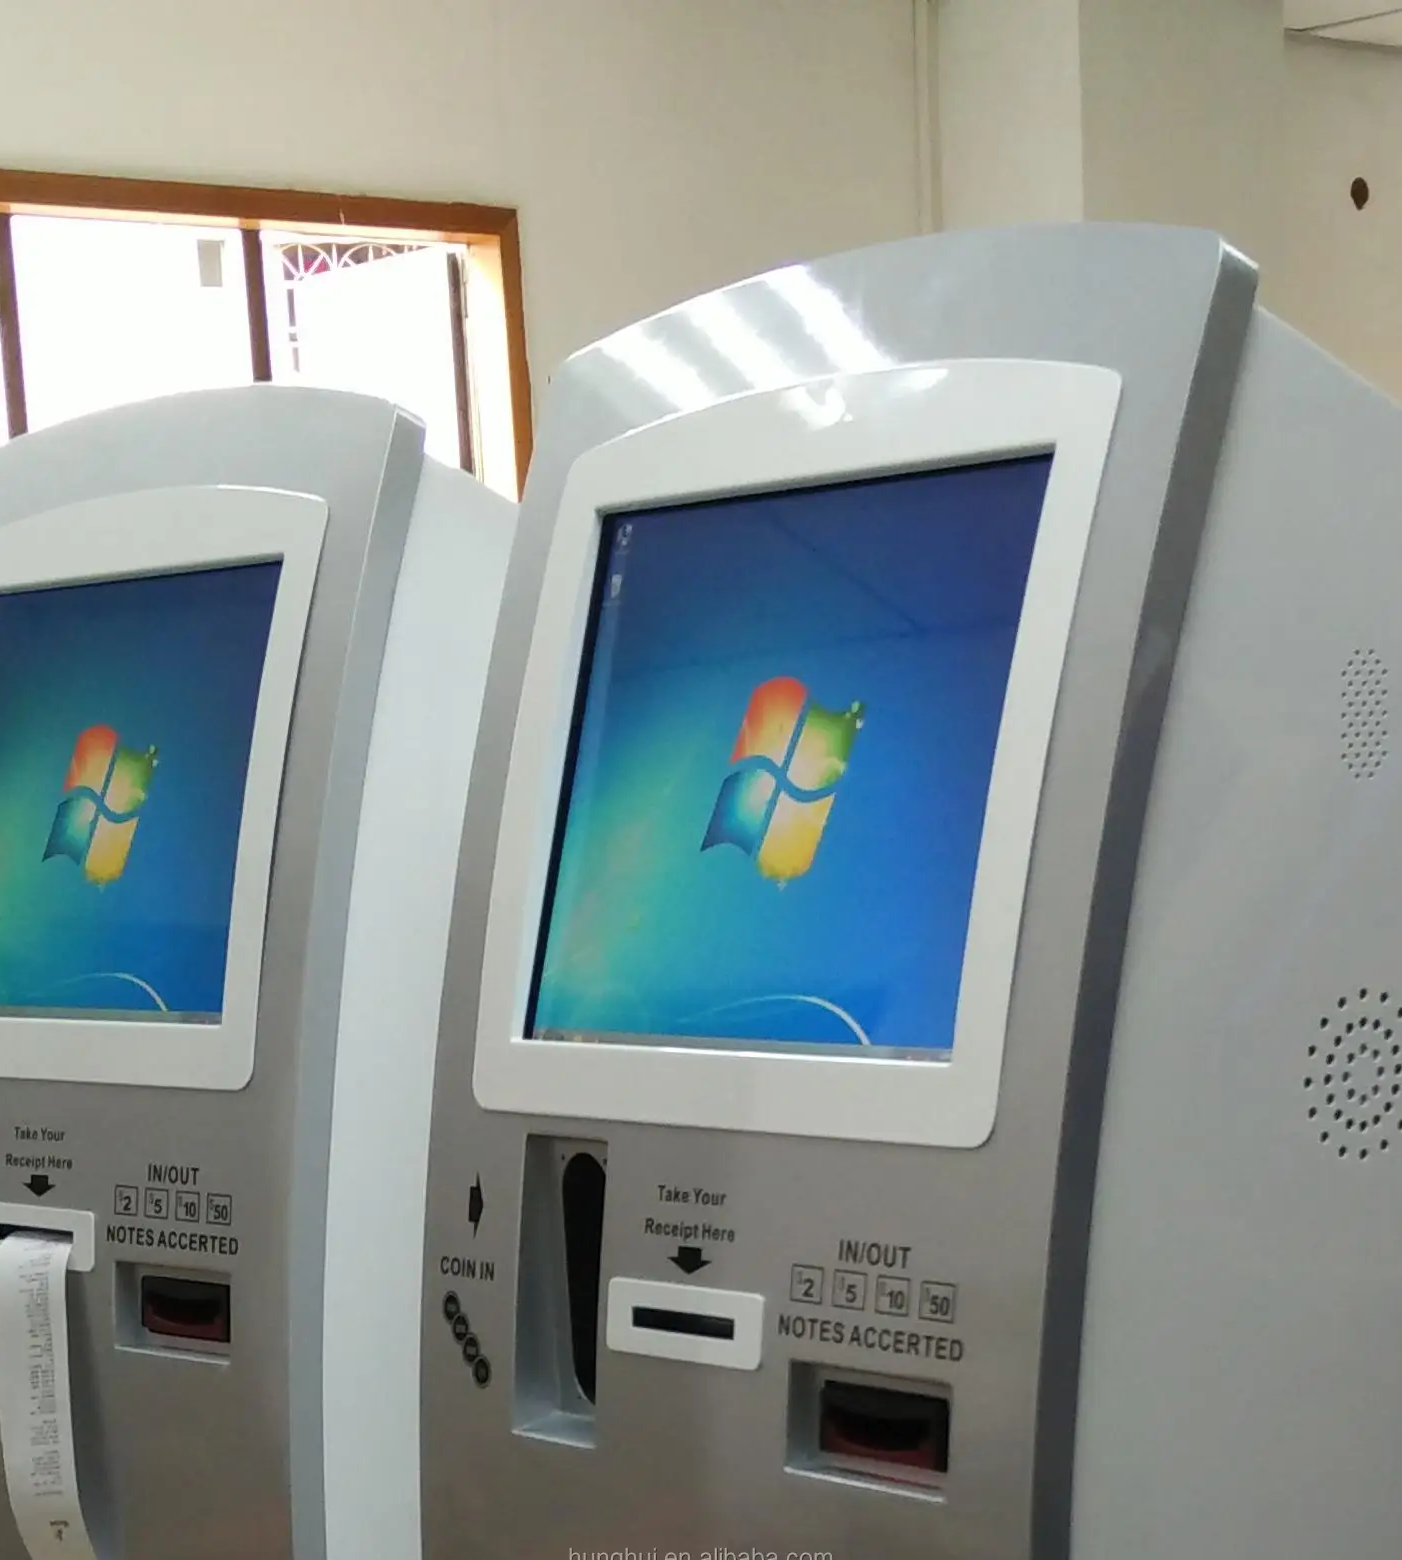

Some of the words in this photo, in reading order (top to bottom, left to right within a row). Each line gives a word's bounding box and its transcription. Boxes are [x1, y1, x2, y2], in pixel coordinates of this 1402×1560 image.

[14, 1125, 38, 1141] Take
[40, 1127, 65, 1143] Your
[5, 1153, 47, 1170] Receipt
[48, 1155, 73, 1170] Here
[147, 1162, 200, 1186] IN/OUT
[657, 1183, 689, 1205] Take
[692, 1187, 727, 1208] Your
[106, 1224, 154, 1247] NOTES
[157, 1230, 239, 1256] ACCERTED
[644, 1217, 699, 1243] Receipt
[702, 1223, 736, 1243] Here
[838, 1238, 912, 1269] IN/OUT
[440, 1255, 477, 1279] COIN
[479, 1260, 494, 1282] IN
[778, 1314, 845, 1344] NOTES
[848, 1324, 964, 1362] ACCERTED
